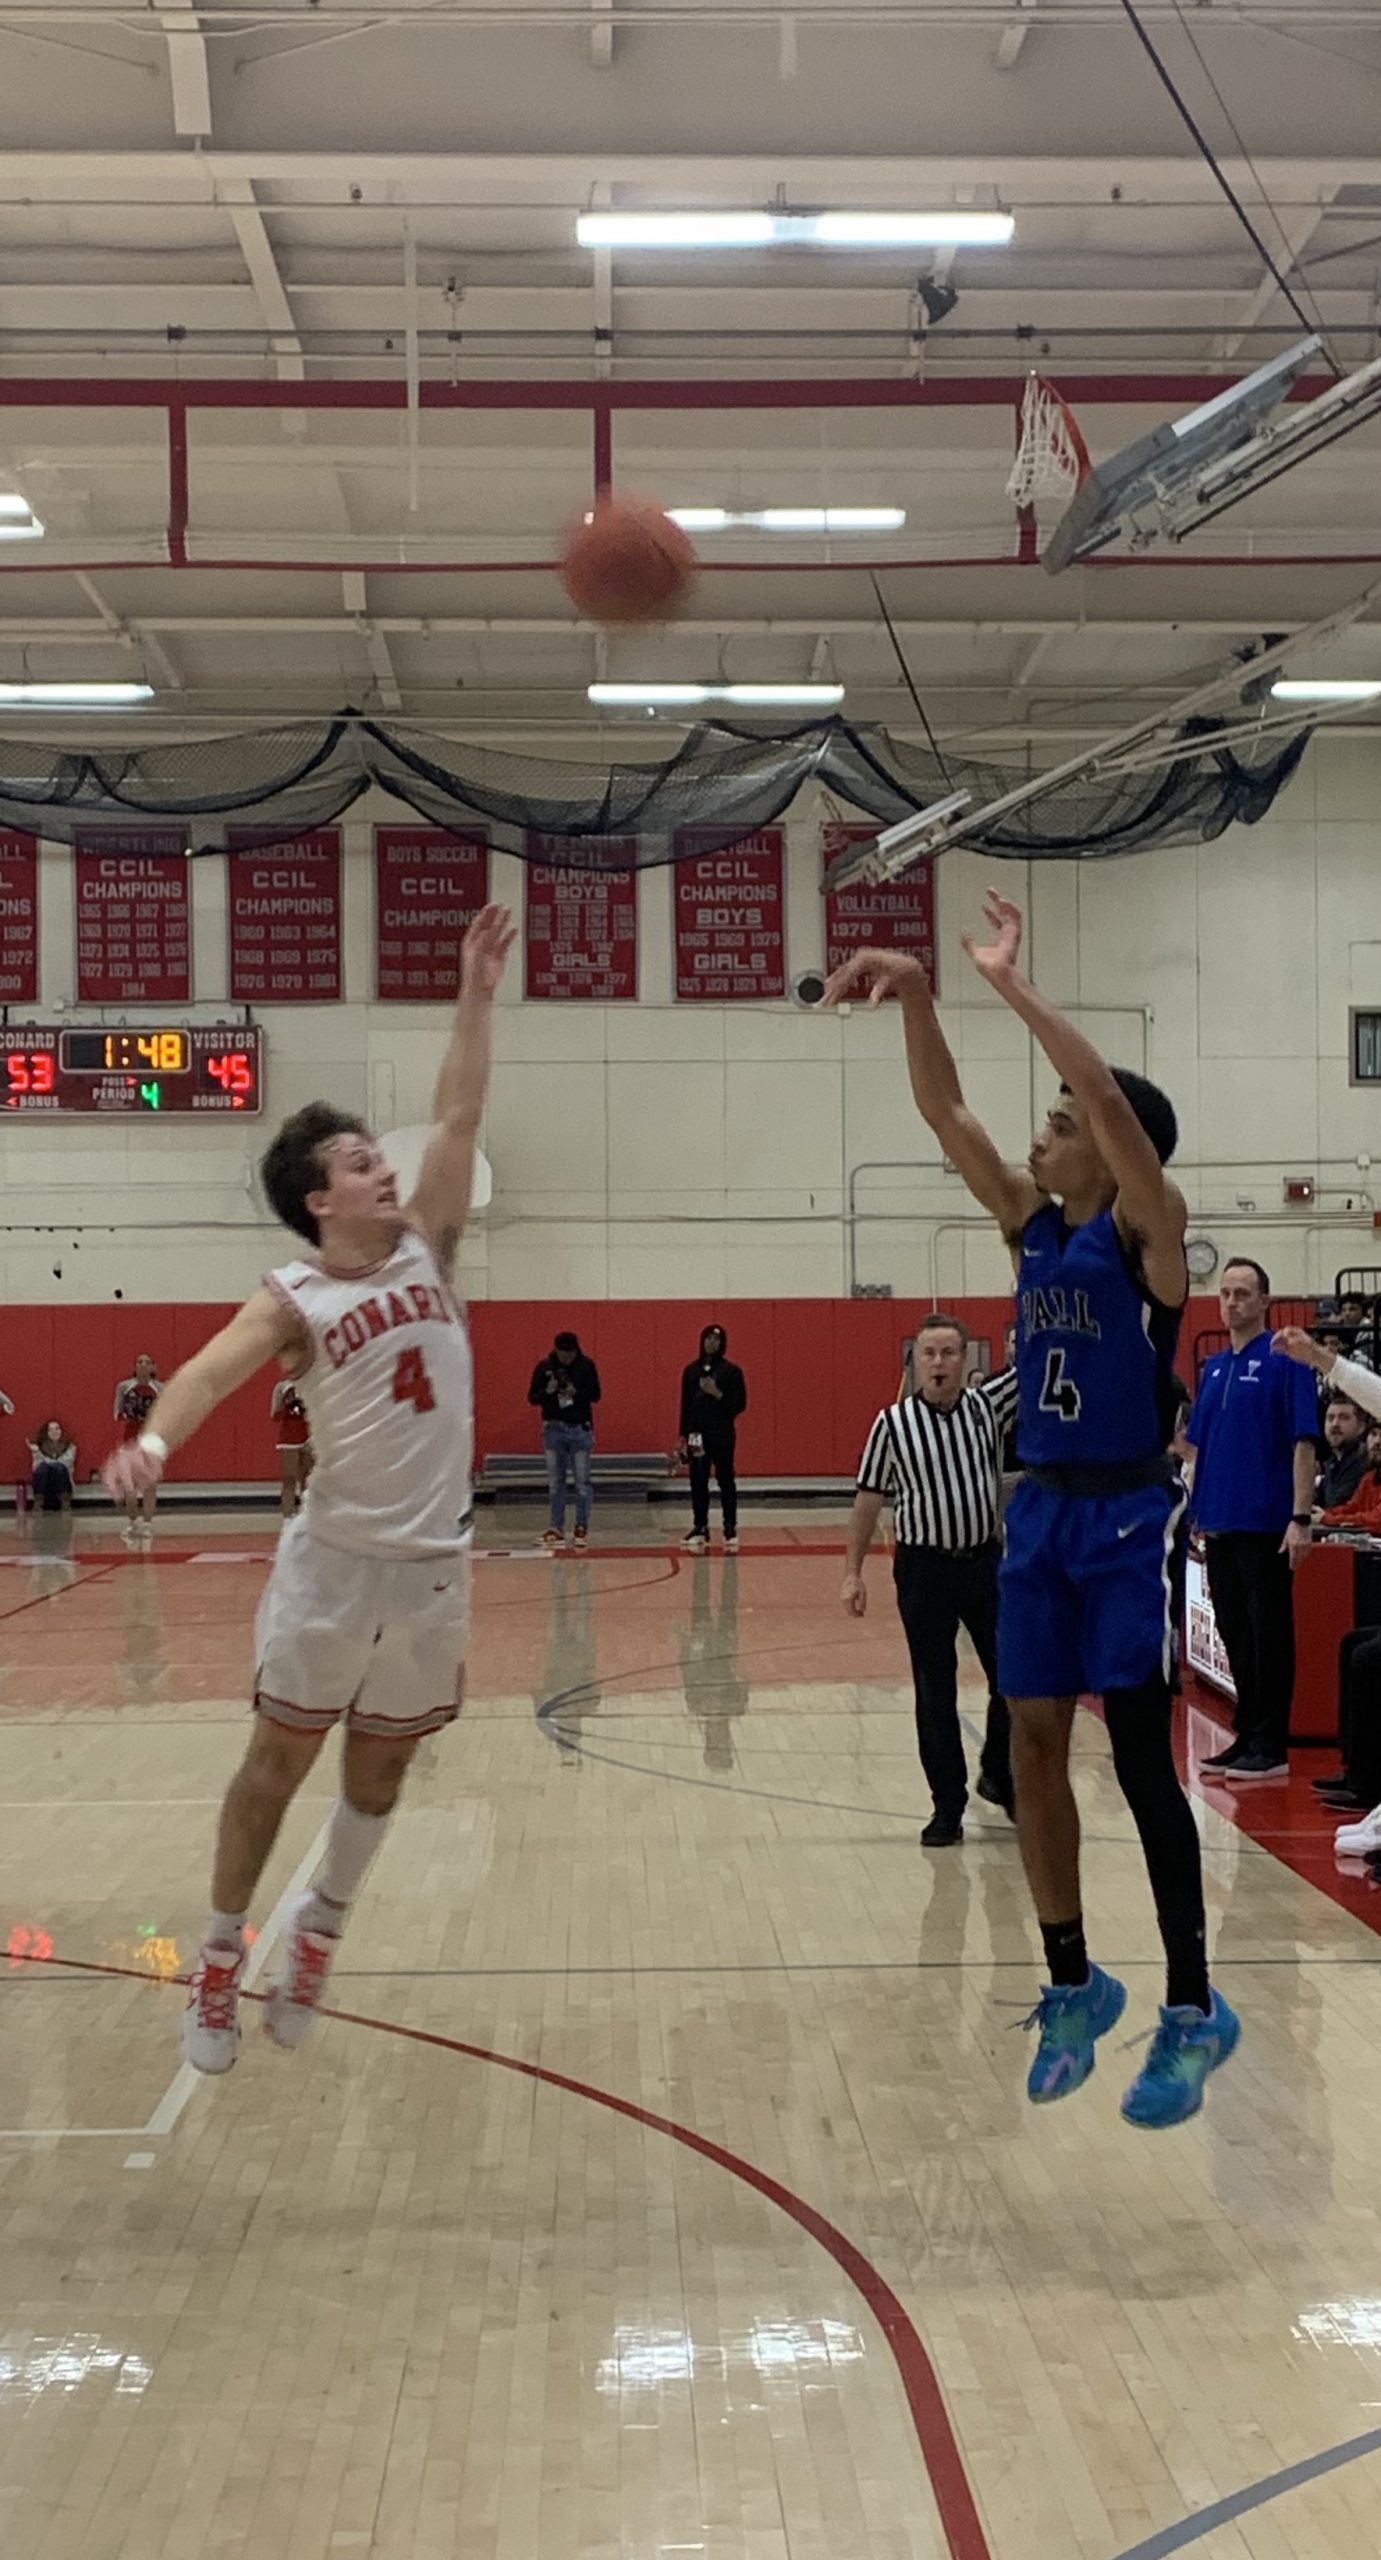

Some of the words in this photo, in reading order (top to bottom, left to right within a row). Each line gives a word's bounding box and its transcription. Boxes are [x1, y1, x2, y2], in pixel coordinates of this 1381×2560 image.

[238, 843, 328, 861] BASEBALL
[387, 846, 421, 863] BOYS
[426, 846, 478, 863] SOCCER
[100, 859, 164, 876] CCIL
[533, 867, 630, 884] CHAMPIONS
[696, 861, 759, 878] CCIL
[252, 871, 316, 888] CCIL
[401, 878, 464, 895] CCIL
[83, 881, 182, 898] CHAMPIONS
[555, 885, 608, 898] BOYS
[680, 884, 777, 901] CHAMPIONS
[235, 897, 334, 915] CHAMPIONS
[836, 894, 922, 911] VOLLEYBALL
[696, 908, 762, 924] BOYS
[553, 953, 610, 966] GIRLS
[694, 953, 767, 970] GIRLS
[193, 1032, 256, 1049] VISITOR
[105, 1034, 182, 1069] 1:48
[8, 1055, 54, 1092] 53
[208, 1054, 252, 1090] 45
[19, 1096, 59, 1108] BONUS
[92, 1087, 135, 1101] PERIOD
[140, 1081, 160, 1110] 4
[192, 1095, 230, 1108] BONUS
[392, 1346, 436, 1414] 4
[1039, 1348, 1082, 1422] 4
